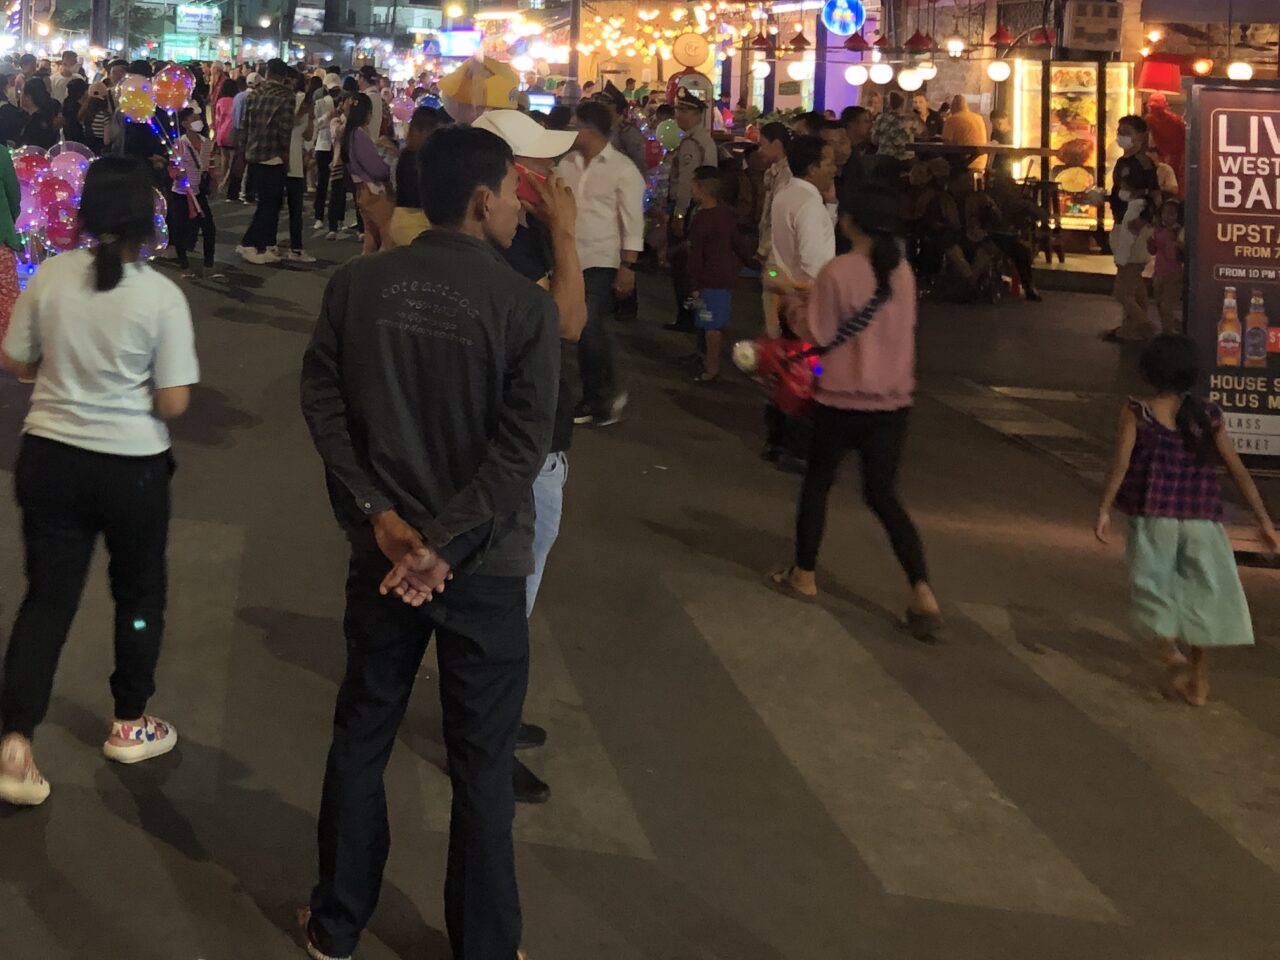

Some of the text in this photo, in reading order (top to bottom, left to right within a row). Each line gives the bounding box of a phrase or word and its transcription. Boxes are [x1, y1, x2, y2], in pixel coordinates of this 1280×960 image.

[1218, 176, 1280, 210] BA
[1217, 223, 1280, 244] UPST
[1235, 246, 1271, 258] FROM
[1219, 267, 1246, 278] FROM
[1261, 269, 1275, 279] PM
[1210, 374, 1268, 391] HOUSE
[1209, 392, 1259, 408] PLUS
[1228, 417, 1261, 430] LASS
